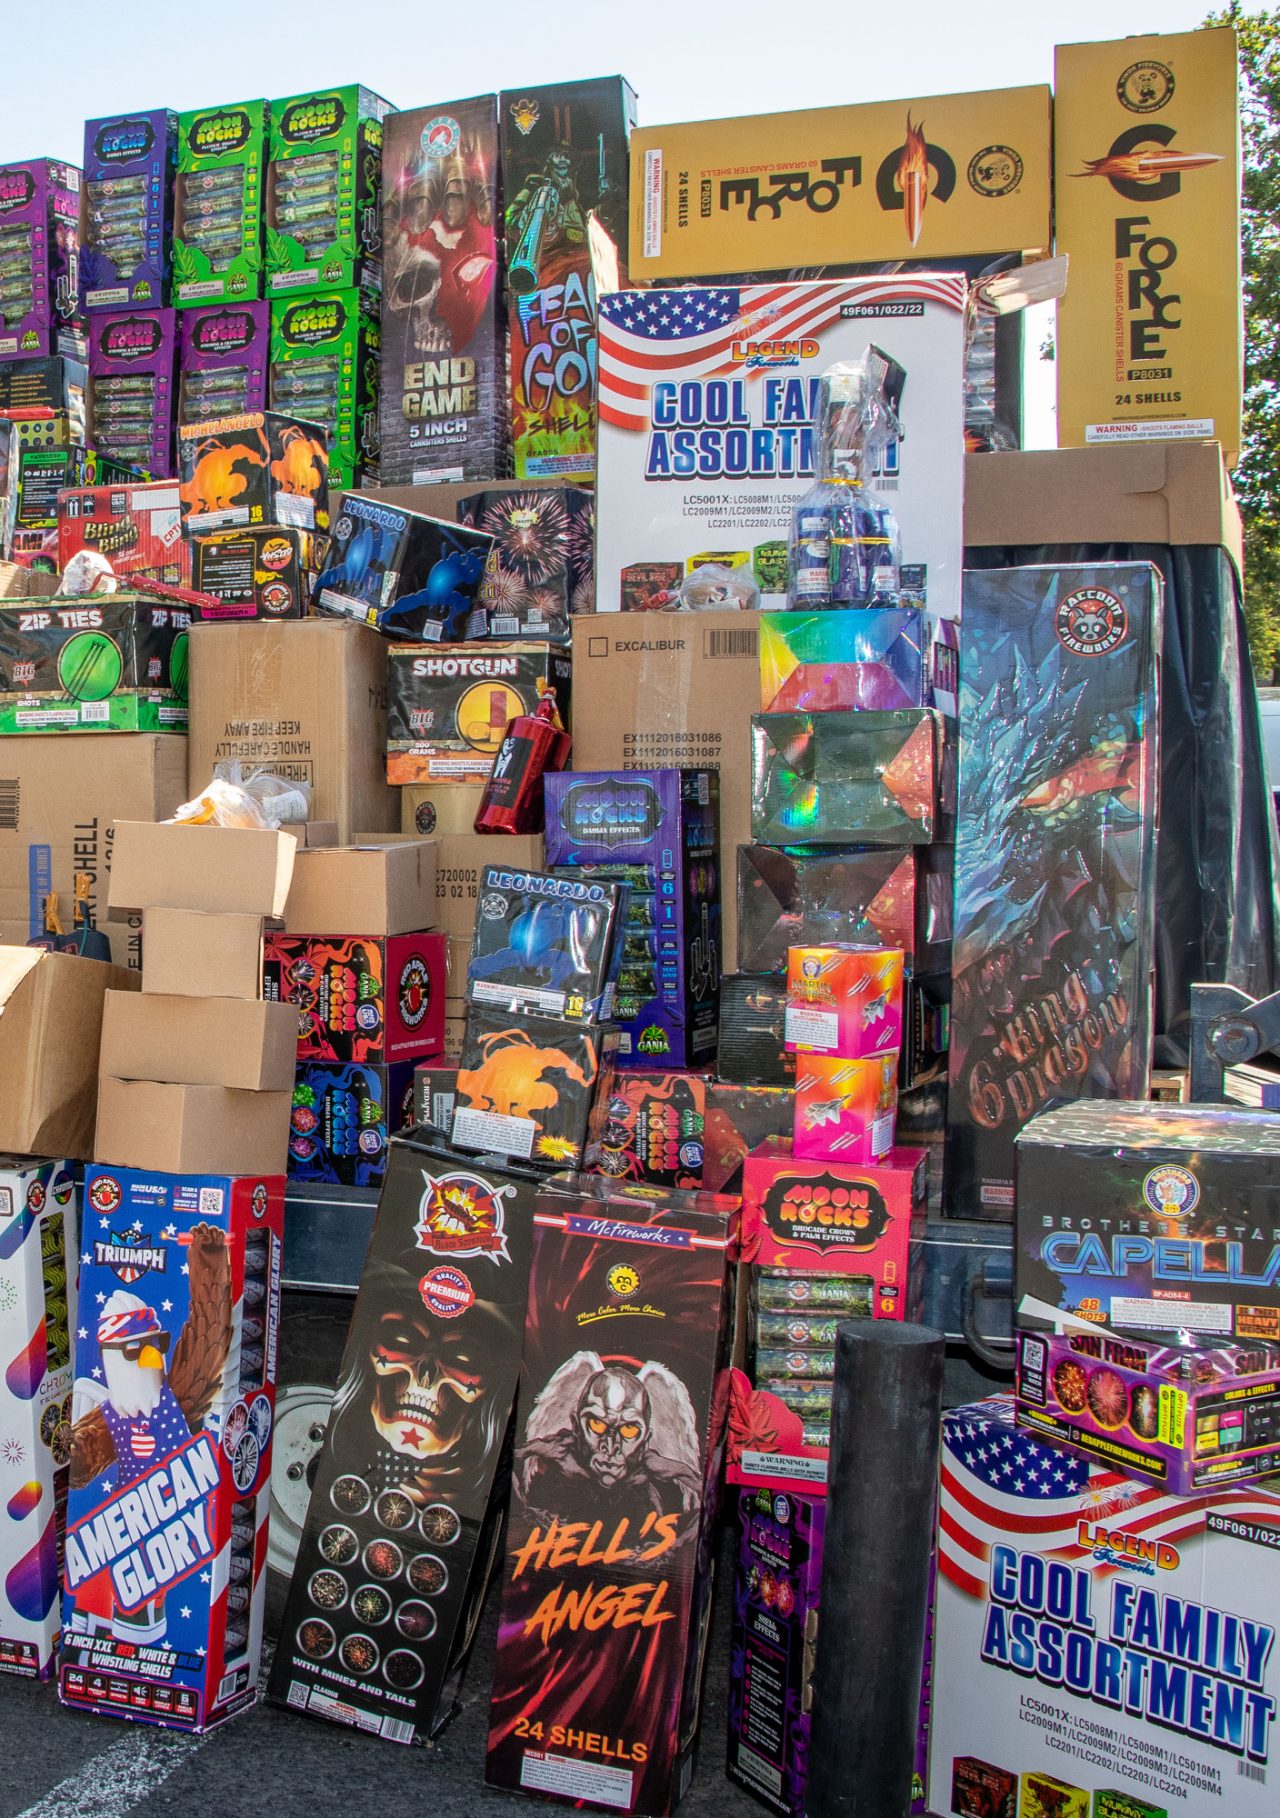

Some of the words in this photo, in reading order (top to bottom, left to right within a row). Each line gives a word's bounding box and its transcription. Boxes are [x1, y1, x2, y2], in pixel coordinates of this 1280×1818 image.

[1107, 123, 1181, 203] G
[678, 172, 688, 185] 24
[720, 156, 862, 222] FORCE
[678, 188, 688, 228] SHELLS
[702, 182, 711, 217] P8031
[1114, 215, 1182, 361] FORCE
[841, 304, 922, 316] 49F061/022/22
[551, 316, 592, 348] OF
[732, 340, 820, 361] LEGEND
[404, 357, 476, 391] END
[1131, 369, 1170, 380] P8031
[402, 388, 477, 421] GAME
[1115, 394, 1131, 406] 24
[1135, 391, 1182, 404] SHELLS
[179, 412, 265, 441] MICHELANGELO
[409, 424, 420, 438] 5
[424, 419, 468, 437] INCH
[683, 495, 733, 505] LC5001X:
[250, 506, 263, 518] 16
[343, 498, 407, 531] LEONARDO
[368, 607, 377, 620] 16
[1058, 588, 1125, 618] RACCOON
[19, 612, 52, 632] ZIP
[58, 610, 103, 629] TIES
[615, 640, 686, 653] EXCALIBUR
[1058, 624, 1125, 655] FIREWORKS
[412, 659, 518, 677] SHOTGUN
[224, 722, 249, 737] AWAY
[252, 721, 273, 736] FIRE
[275, 720, 301, 735] KEEP
[410, 712, 435, 725] BIG
[623, 733, 723, 744] EX1112016031086
[623, 747, 722, 758] EX1112016031087
[576, 789, 647, 809] MOON
[574, 804, 649, 825] ROCKS
[487, 870, 605, 902] LEONARDO
[661, 882, 674, 896] 6
[329, 964, 344, 1032] ROCKS
[342, 967, 358, 1032] MOON
[568, 995, 584, 1010] 16
[648, 1100, 664, 1172] ROCKS
[664, 1103, 678, 1169] MOON
[783, 1184, 870, 1209] MOON
[779, 1202, 871, 1229] ROCKS
[792, 1224, 829, 1236] BROCADE
[830, 1228, 857, 1238] CROWN
[95, 1241, 167, 1270] TRIUMPH
[272, 1234, 284, 1291] GLORY
[436, 1273, 464, 1288] QUALITY
[423, 1281, 472, 1304] PREMIUM
[430, 1298, 457, 1312] QUALITY
[881, 1298, 894, 1313] 6
[1079, 1298, 1100, 1312] 48
[1237, 1315, 1278, 1327] HEAVY
[1239, 1325, 1278, 1337] WEIGHTS
[267, 1301, 280, 1386] AMERICAN
[766, 1455, 805, 1468] WARNING
[1081, 1430, 1163, 1472] REDAPPLEFIREWORKS.COM
[66, 1440, 219, 1588] AMERICAN
[111, 1502, 212, 1608] GLORY
[512, 1508, 681, 1588] HELL'S
[1077, 1521, 1179, 1572] LEGEND
[524, 1580, 678, 1647] ANGEL
[757, 1613, 777, 1632] SHELL
[989, 1543, 1095, 1633] COOL
[1109, 1578, 1275, 1687] FAMILY
[754, 1622, 781, 1643] EFFECTS
[91, 1652, 139, 1673] WHISTLING
[138, 1660, 173, 1679] SHELLS
[69, 1672, 84, 1684] 24
[291, 1655, 320, 1674] WITH
[320, 1667, 359, 1688] MINES
[358, 1682, 383, 1698] AND
[384, 1690, 418, 1708] TAILS
[980, 1601, 1277, 1762] ASSORTMENT
[514, 1716, 546, 1742] 24
[549, 1725, 649, 1763] SHELLS
